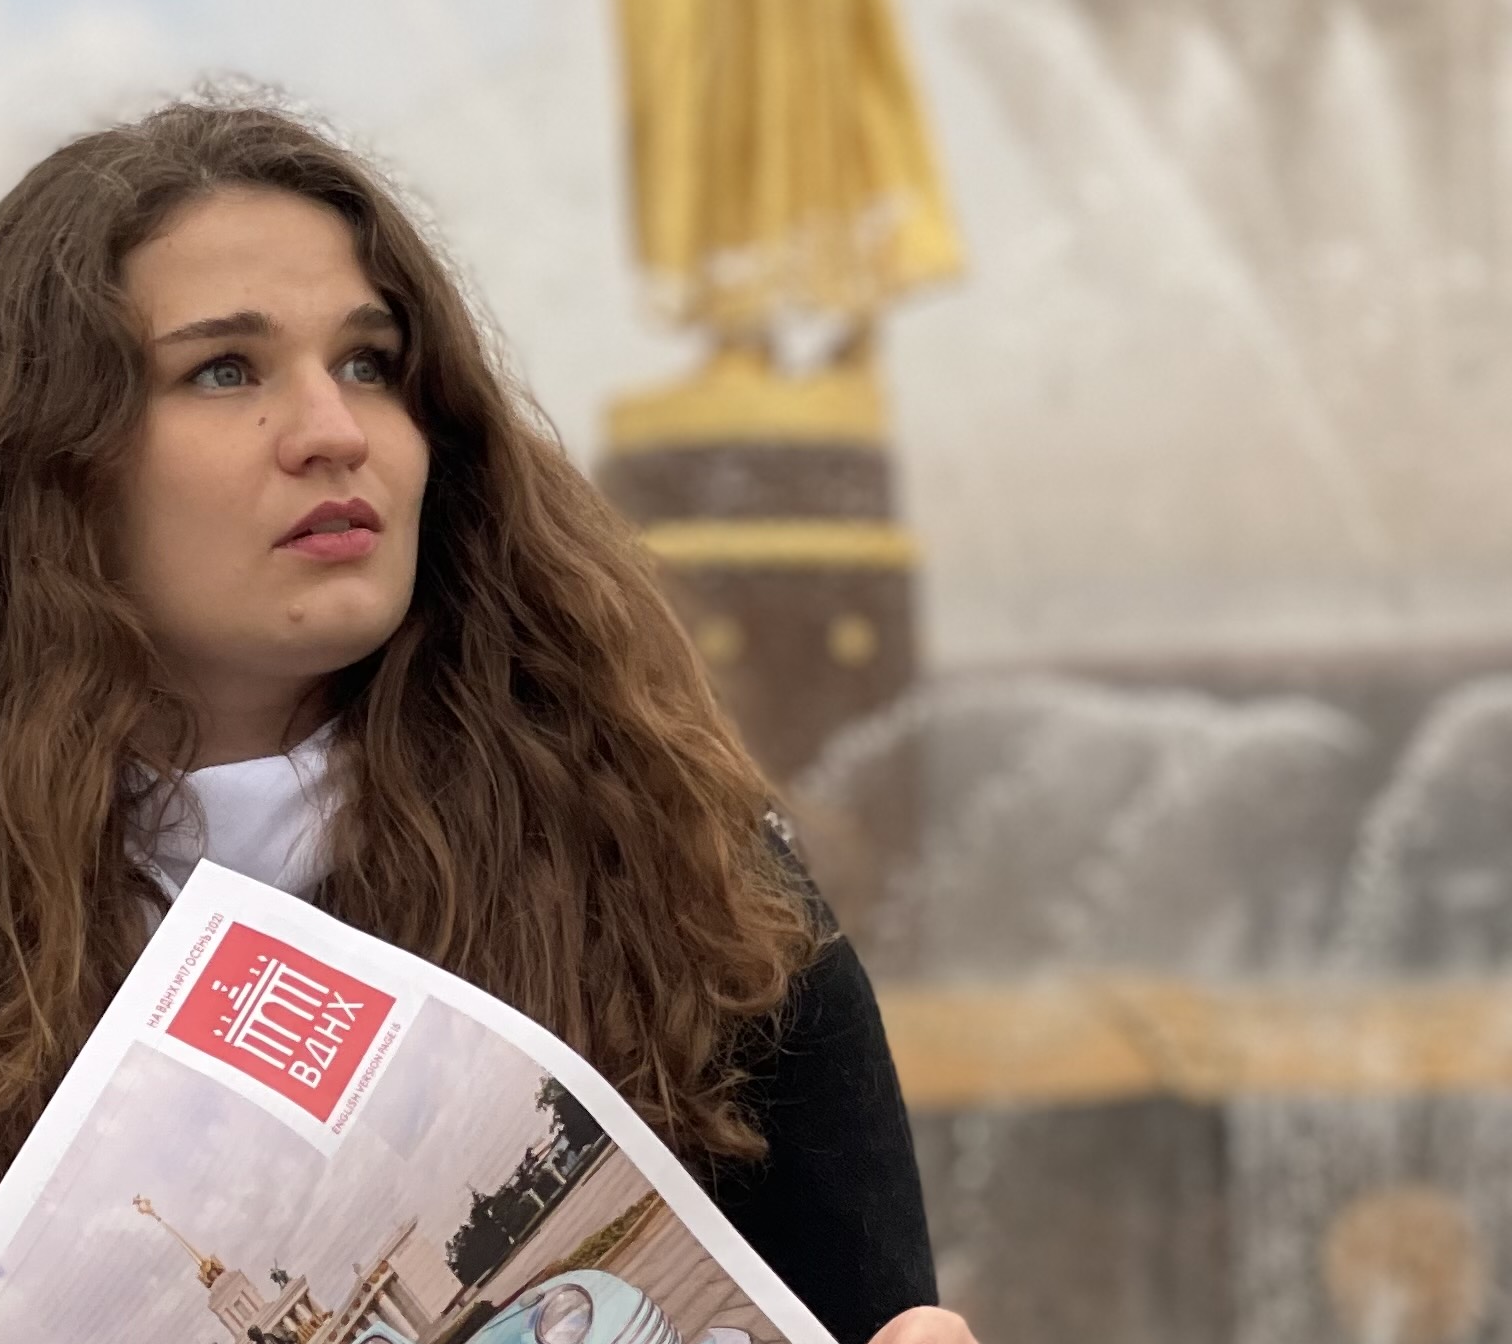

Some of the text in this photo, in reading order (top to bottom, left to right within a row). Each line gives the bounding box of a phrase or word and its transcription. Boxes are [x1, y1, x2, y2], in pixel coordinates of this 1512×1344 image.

[147, 1014, 162, 1028] НА
[156, 985, 179, 1013] ВДНХ
[186, 935, 212, 966] ОСЕНЬ
[205, 913, 224, 934] 2021
[288, 991, 364, 1089] ВДНХ
[332, 1093, 360, 1135] ENGLISH
[356, 1054, 383, 1092] VERSION
